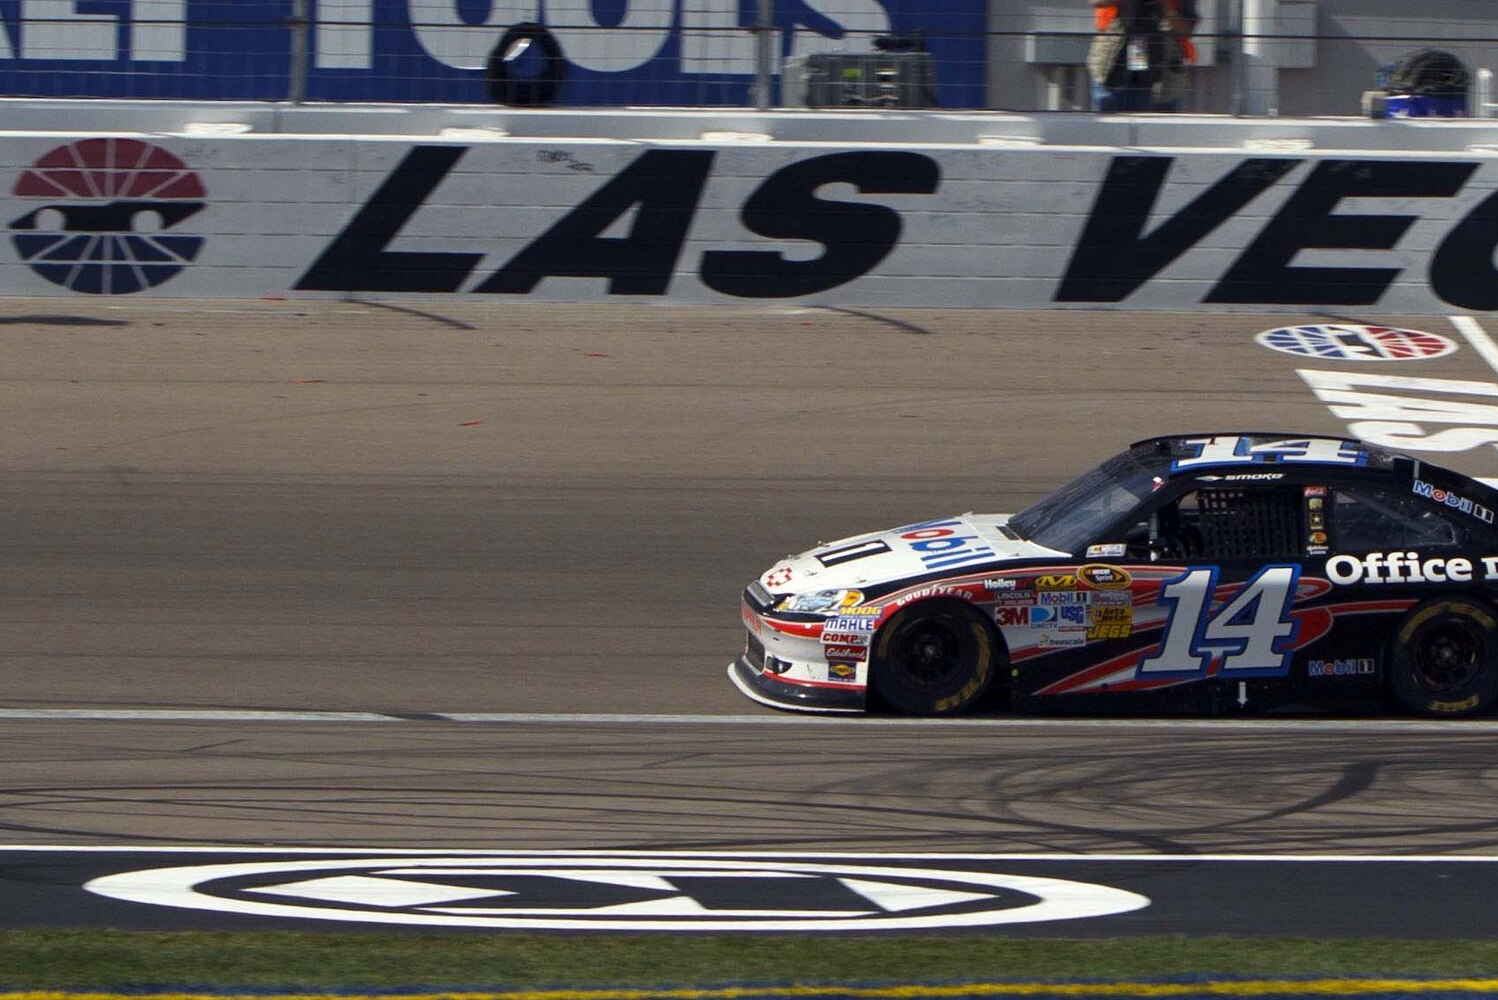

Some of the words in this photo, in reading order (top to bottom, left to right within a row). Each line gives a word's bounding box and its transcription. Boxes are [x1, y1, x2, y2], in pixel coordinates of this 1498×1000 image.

[292, 145, 941, 300] LAS
[1412, 478, 1473, 518] Mobil
[1325, 551, 1472, 587] Office
[984, 578, 1016, 591] Holley
[1040, 592, 1073, 605] Mobil
[840, 606, 881, 616] MOOG
[997, 607, 1029, 626] 3M
[1061, 606, 1085, 625] USG
[825, 618, 873, 631] MAHLE
[1140, 566, 1296, 676] 14
[1308, 659, 1356, 676] Mobil
